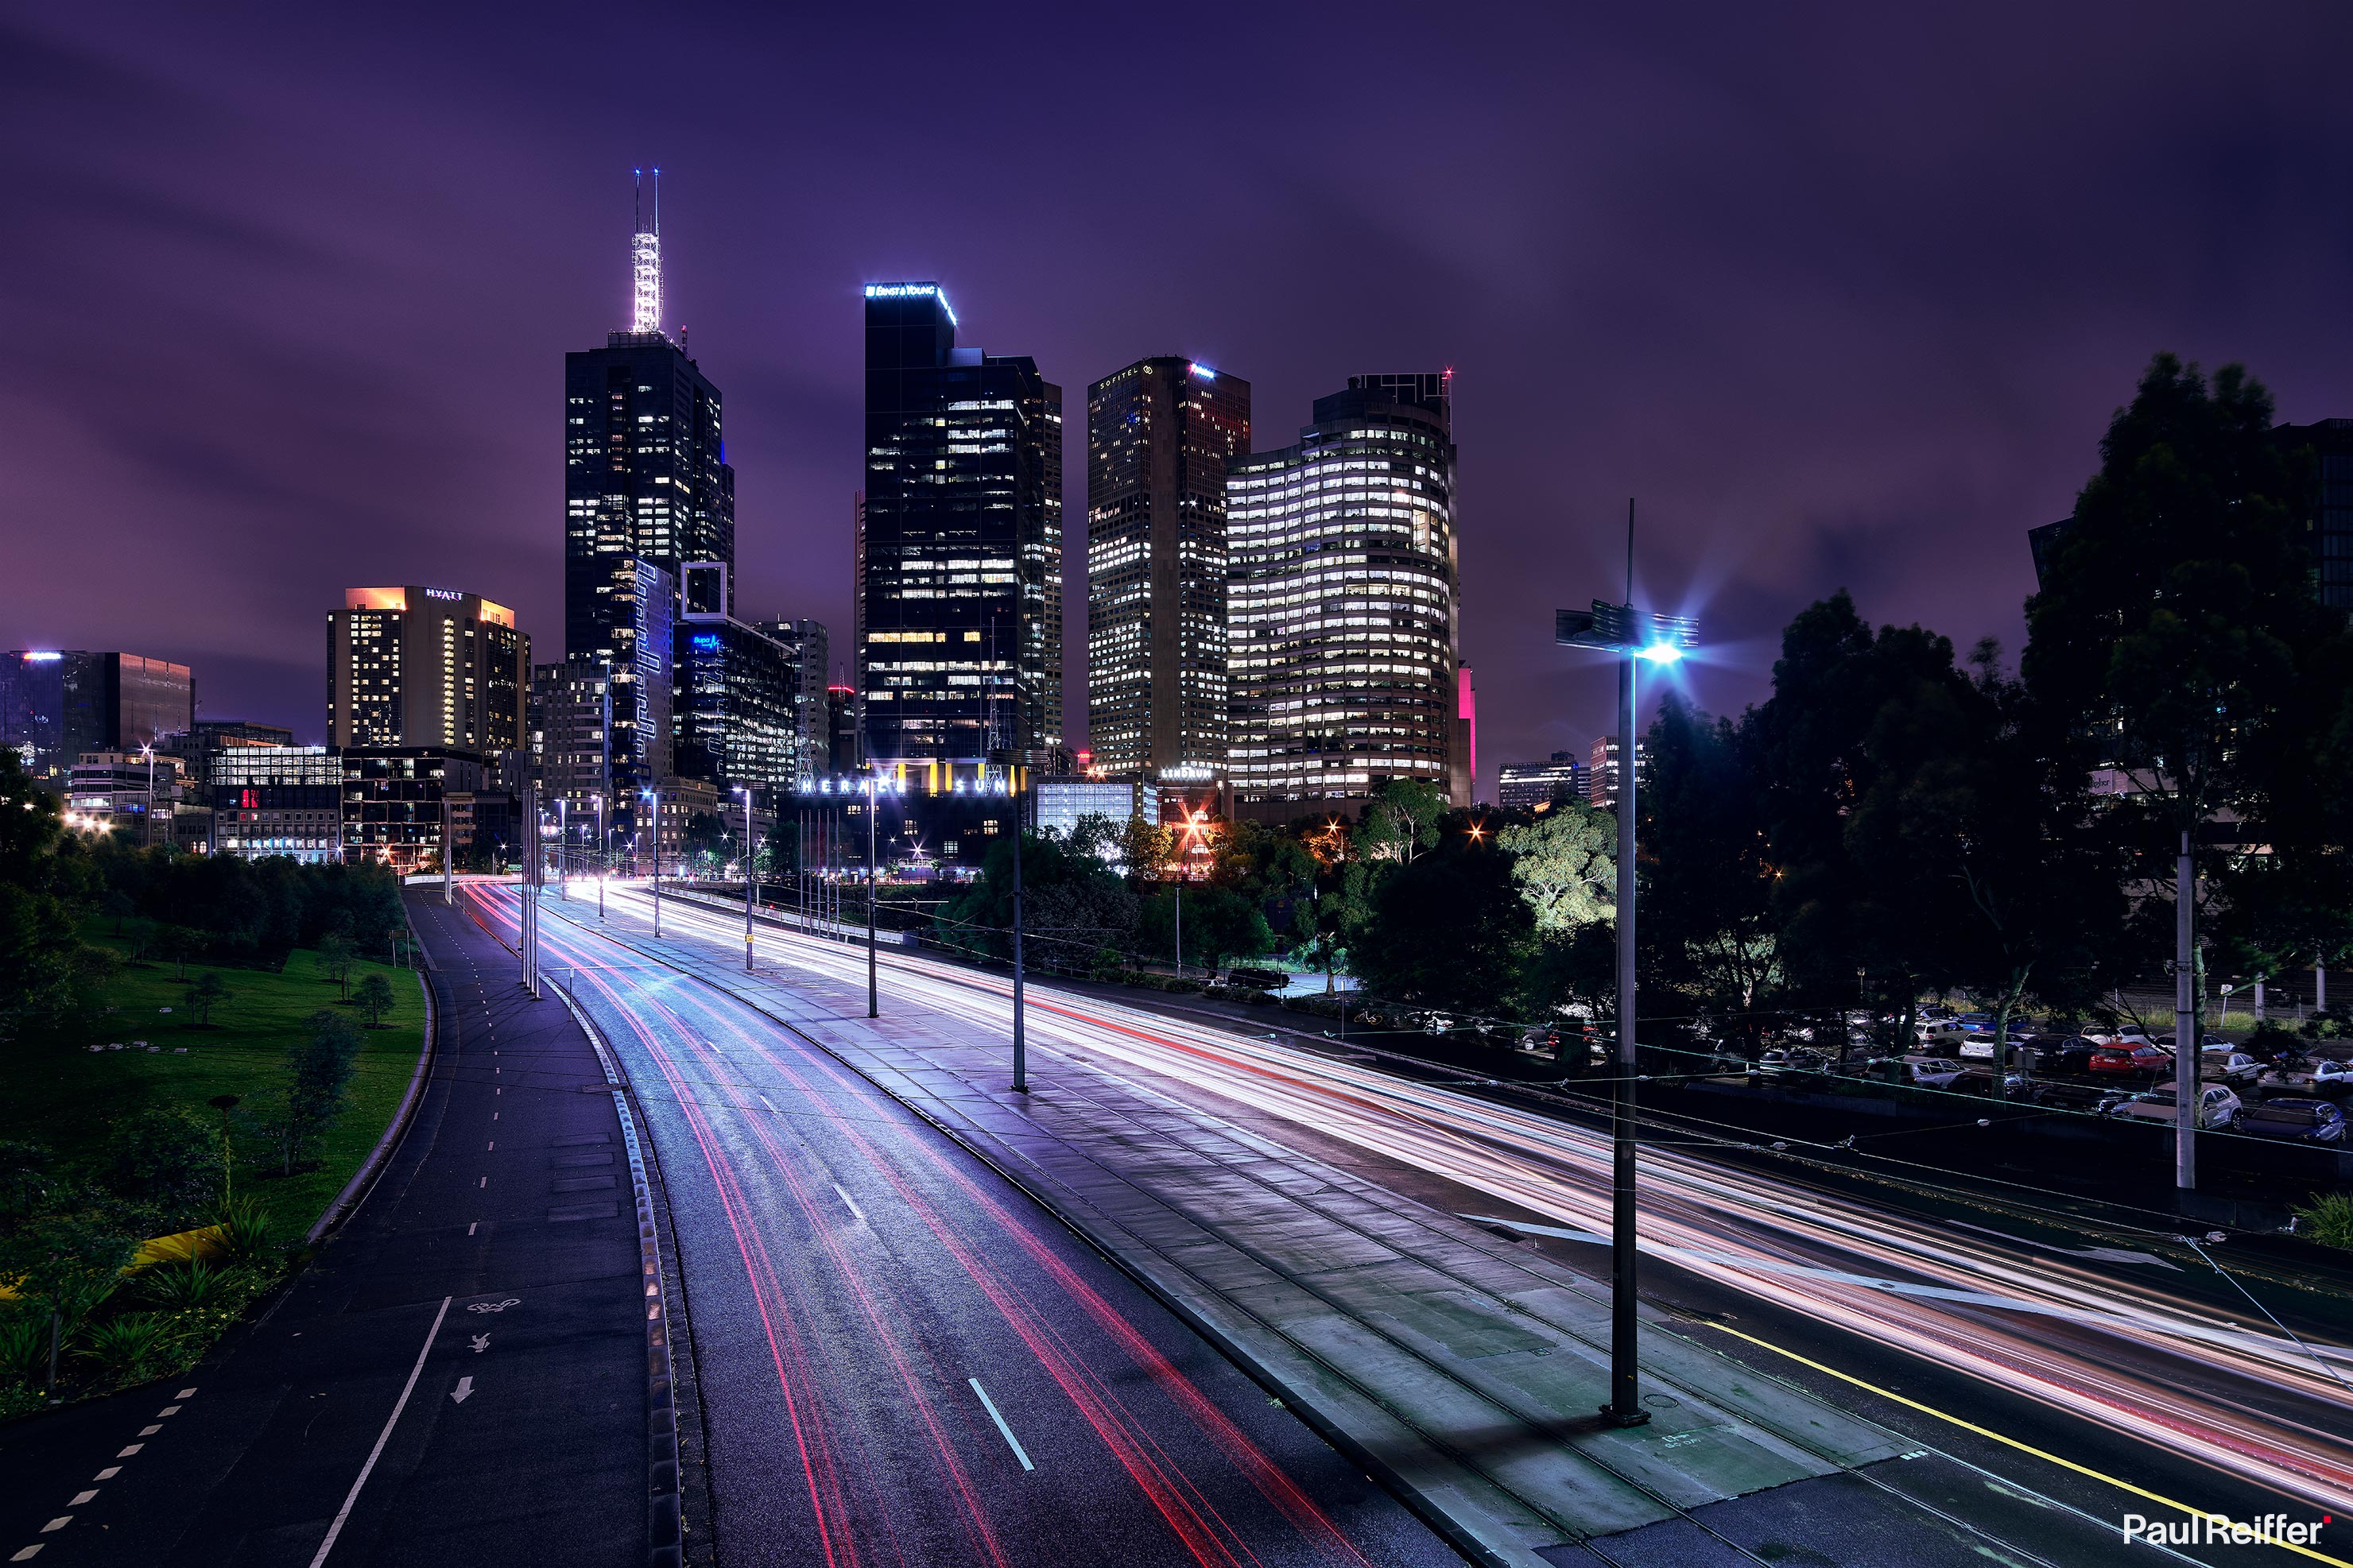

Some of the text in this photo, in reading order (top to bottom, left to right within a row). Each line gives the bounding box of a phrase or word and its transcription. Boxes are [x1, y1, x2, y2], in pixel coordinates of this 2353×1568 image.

[1099, 367, 1138, 389] SOFITEL
[426, 588, 463, 601] HYATT
[1161, 769, 1211, 778] LINDRUM
[956, 780, 1006, 792] SUN
